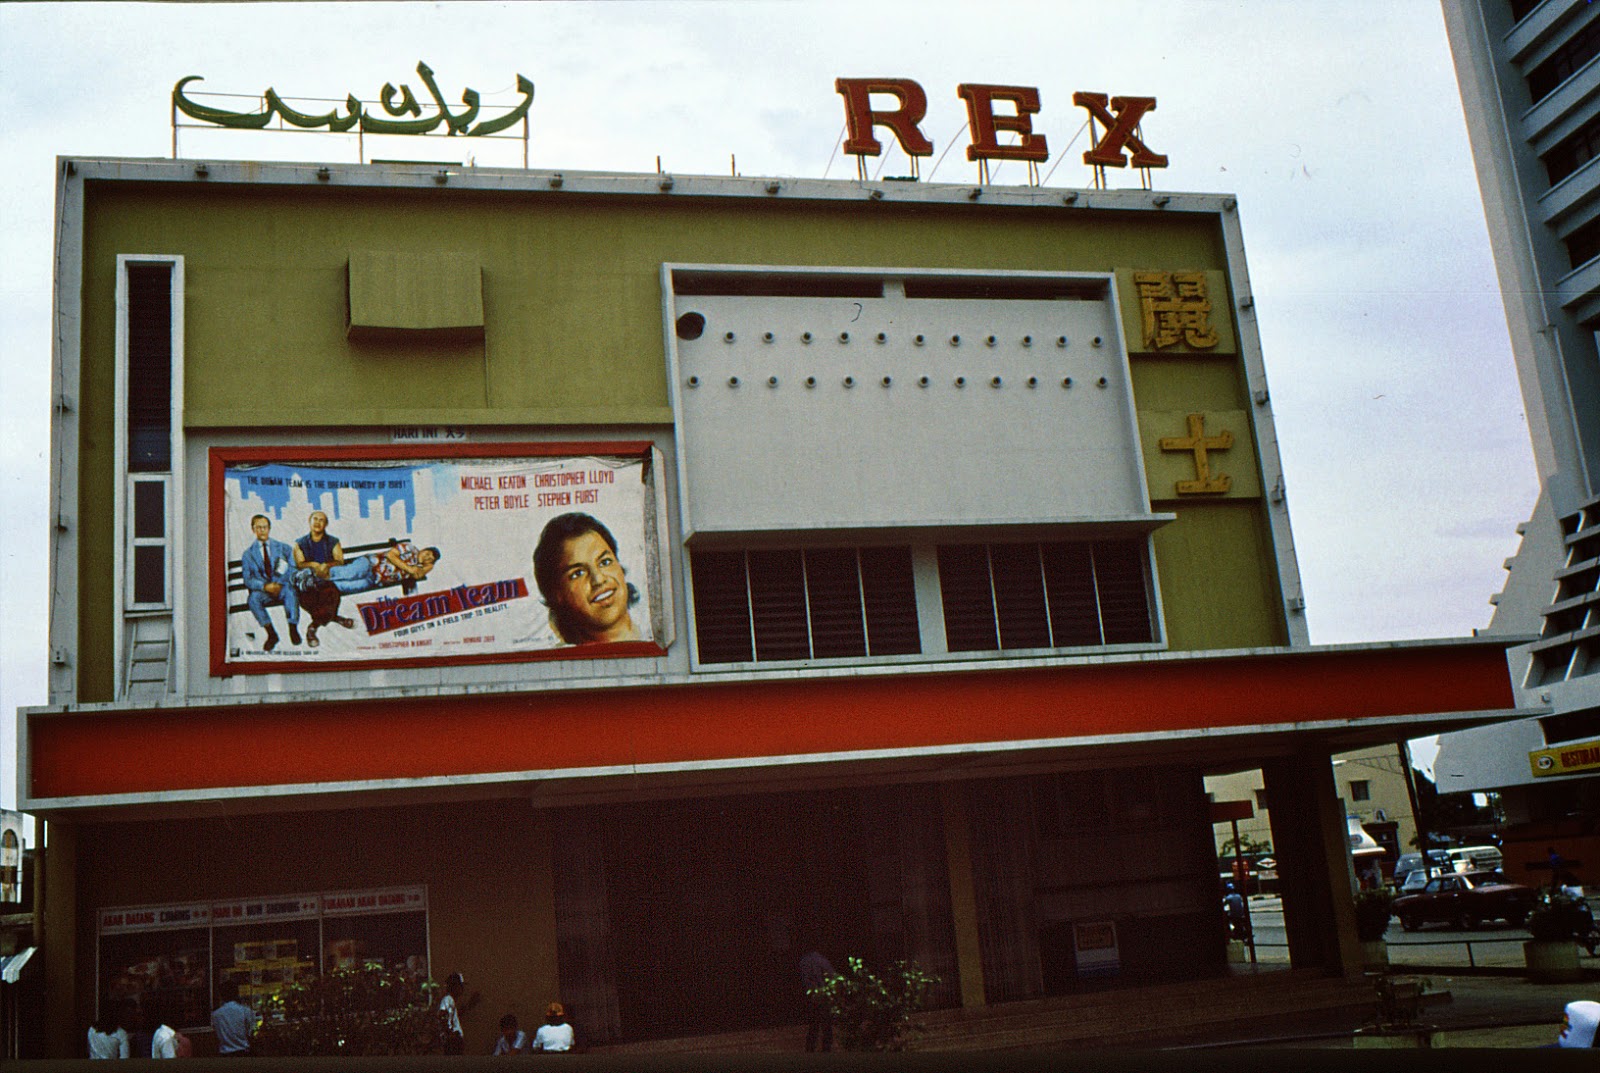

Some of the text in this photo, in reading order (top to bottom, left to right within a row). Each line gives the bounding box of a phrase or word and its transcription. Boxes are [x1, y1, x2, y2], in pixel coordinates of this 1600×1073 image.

[835, 77, 1169, 168] REX
[393, 426, 438, 438] HARI INI
[286, 478, 303, 488] TEAM
[305, 480, 312, 488] IS
[314, 480, 325, 489] THE
[327, 480, 349, 489] DREAM
[352, 480, 377, 489] COMEDY
[378, 480, 386, 489] OF
[461, 475, 527, 491] MICHAEL KEATON
[534, 470, 614, 488] CHRISTOPHER LLOYD
[474, 494, 529, 510] PETER BOYLE
[537, 489, 599, 507] STEPHEN FURST
[360, 578, 520, 632] Dream Team
[376, 595, 399, 608] The
[394, 628, 410, 638] FOUR
[410, 625, 425, 634] GUYS
[427, 622, 436, 630] ON
[443, 616, 460, 626] FIELD
[461, 612, 474, 621] TRIP
[475, 609, 483, 618] TO
